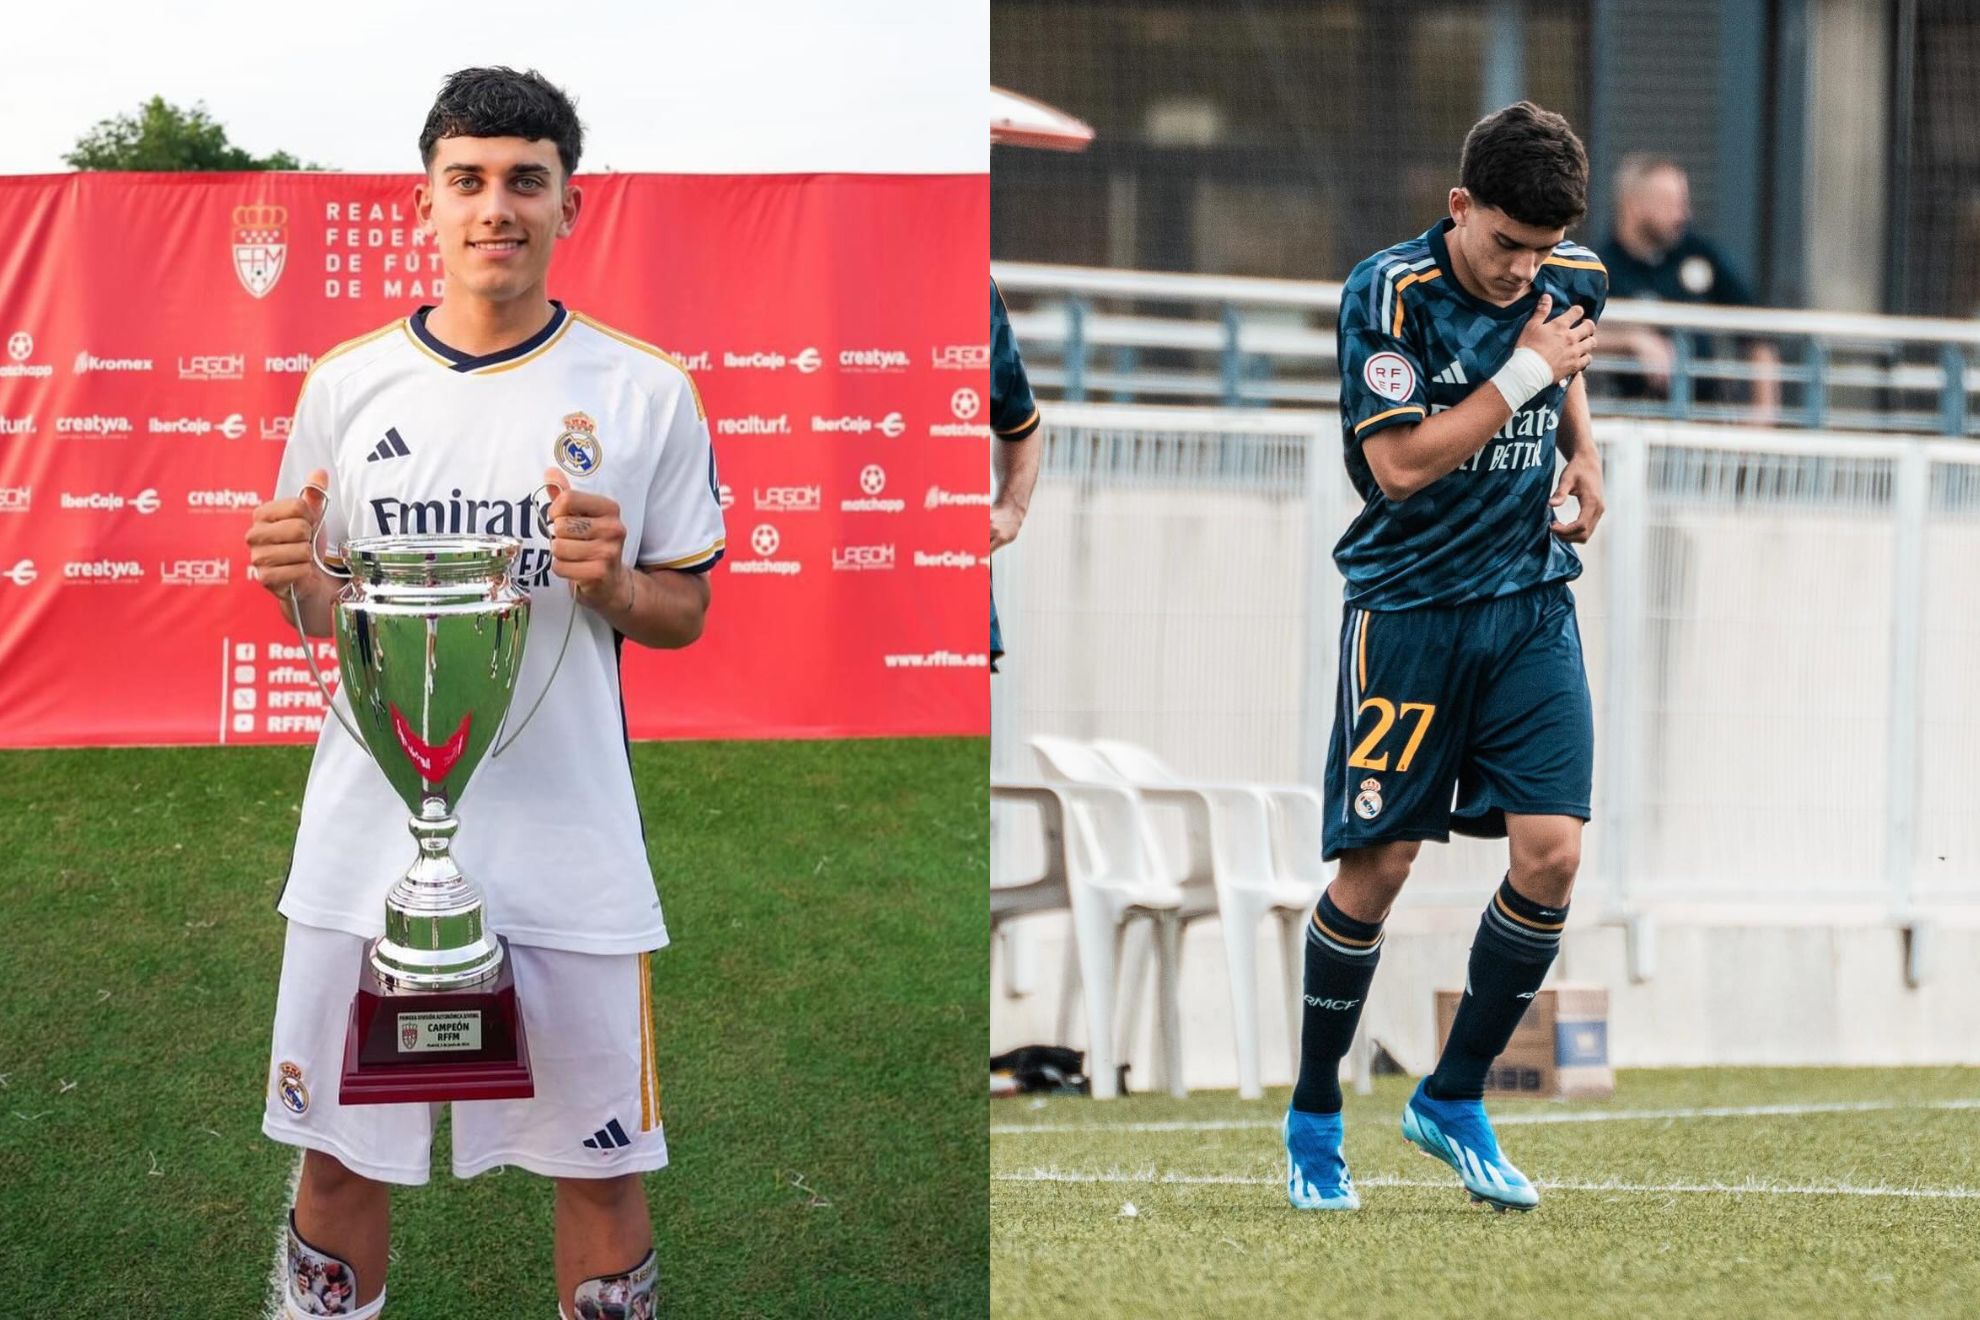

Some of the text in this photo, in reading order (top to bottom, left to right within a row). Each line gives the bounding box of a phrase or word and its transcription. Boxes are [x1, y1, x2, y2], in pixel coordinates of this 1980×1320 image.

[326, 202, 404, 221] REAL
[325, 253, 361, 273] DE
[325, 279, 361, 298] DE
[88, 357, 152, 371] Kromex
[932, 346, 990, 364] LAGO
[268, 643, 314, 660] Real
[1347, 697, 1436, 772] 27
[427, 1020, 470, 1033] CAMPEÓN
[437, 1032, 460, 1041] RFFM
